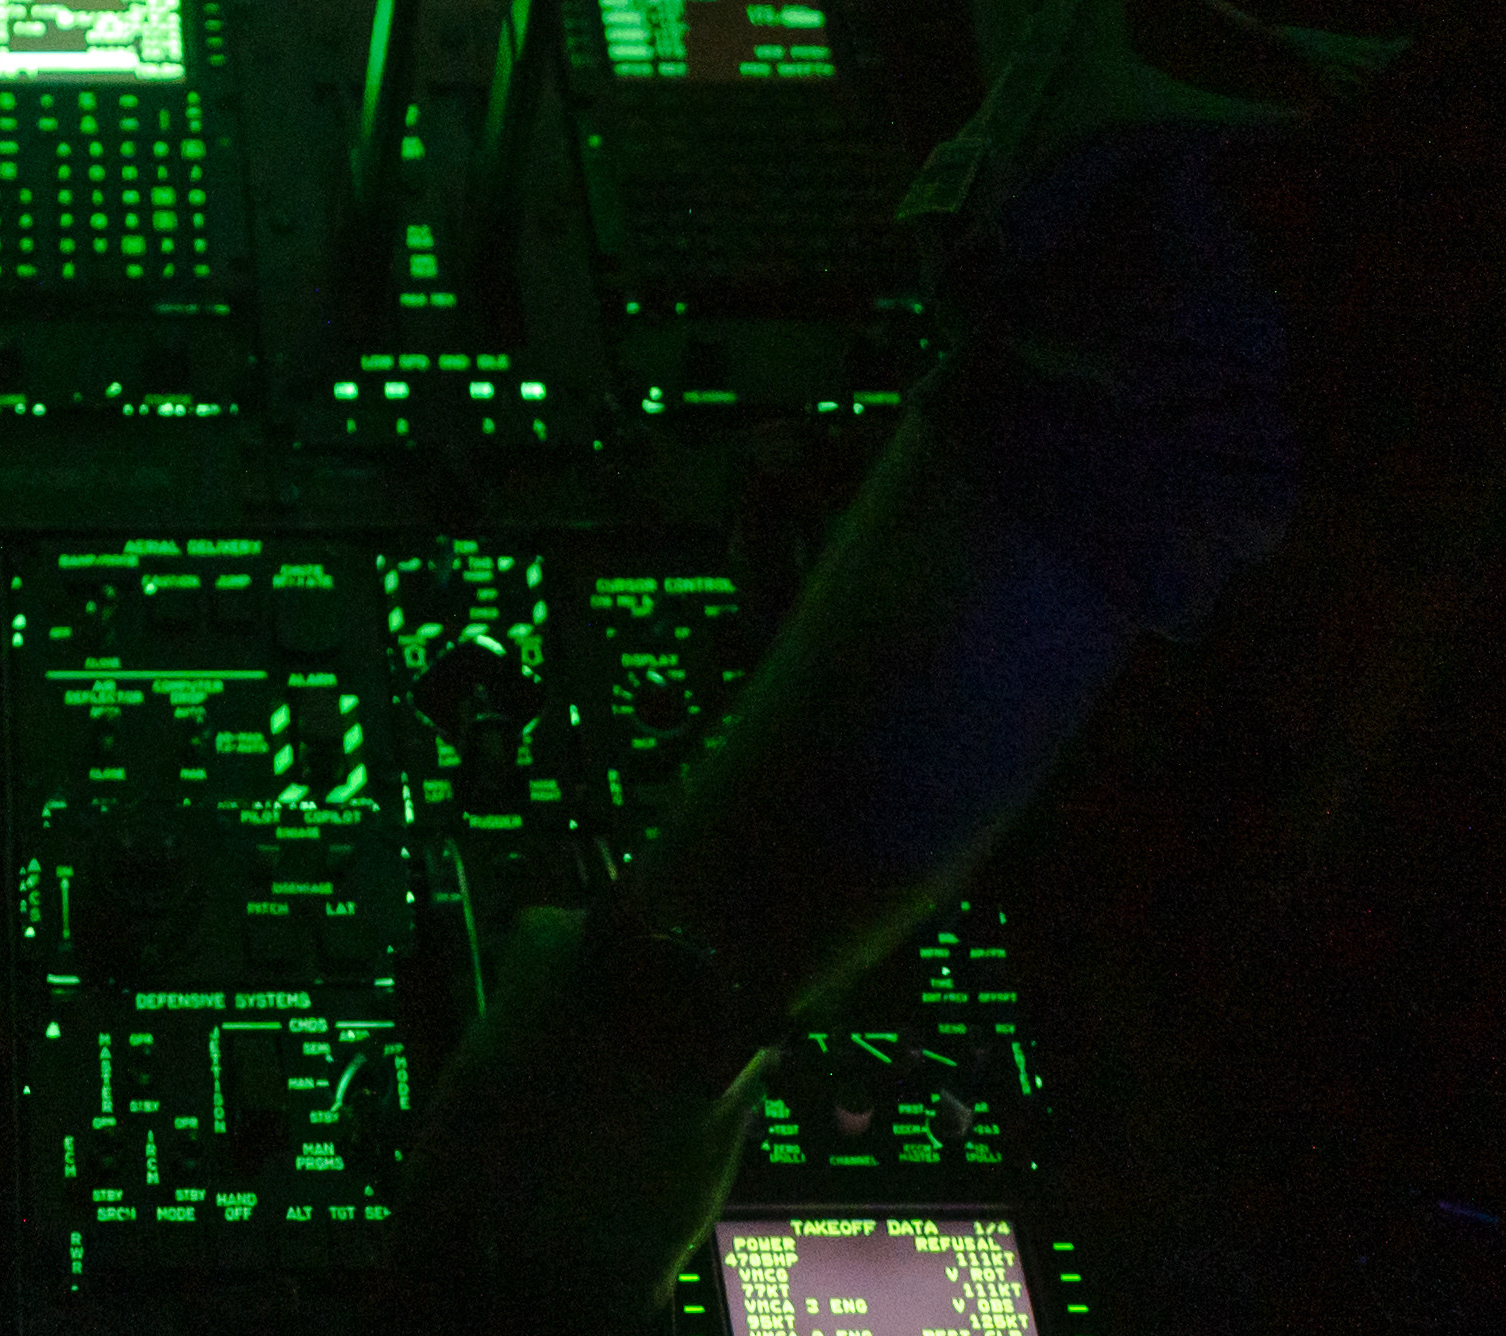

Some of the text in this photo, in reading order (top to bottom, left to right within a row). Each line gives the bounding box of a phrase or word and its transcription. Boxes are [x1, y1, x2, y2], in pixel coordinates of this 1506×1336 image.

[326, 902, 356, 915] LAT
[136, 992, 311, 1009] DEFENSIVE SYSTEMS
[288, 1078, 314, 1089] MAN
[301, 1143, 334, 1157] MAN
[93, 1189, 123, 1201] STBY
[175, 1189, 205, 1201] STBY
[216, 1193, 257, 1207] HAND
[97, 1207, 195, 1221] SRCH MODE
[225, 1207, 252, 1221] OFF
[286, 1206, 312, 1221] ALT
[329, 1206, 356, 1220] TGT
[790, 1218, 1010, 1237] TAKEOFF DATA 1/4
[733, 1236, 796, 1251] POWER
[915, 1236, 1002, 1252] REFUSAL
[70, 1232, 84, 1273] RWR
[957, 1252, 1015, 1267] 111KT
[946, 1266, 1005, 1283] V ROT
[742, 1283, 789, 1298] 77KT
[964, 1282, 1021, 1298] 111KT
[745, 1297, 868, 1315] VMCA 3 ENG
[952, 1297, 1014, 1314] V OBS
[970, 1313, 1028, 1329] 125KT
